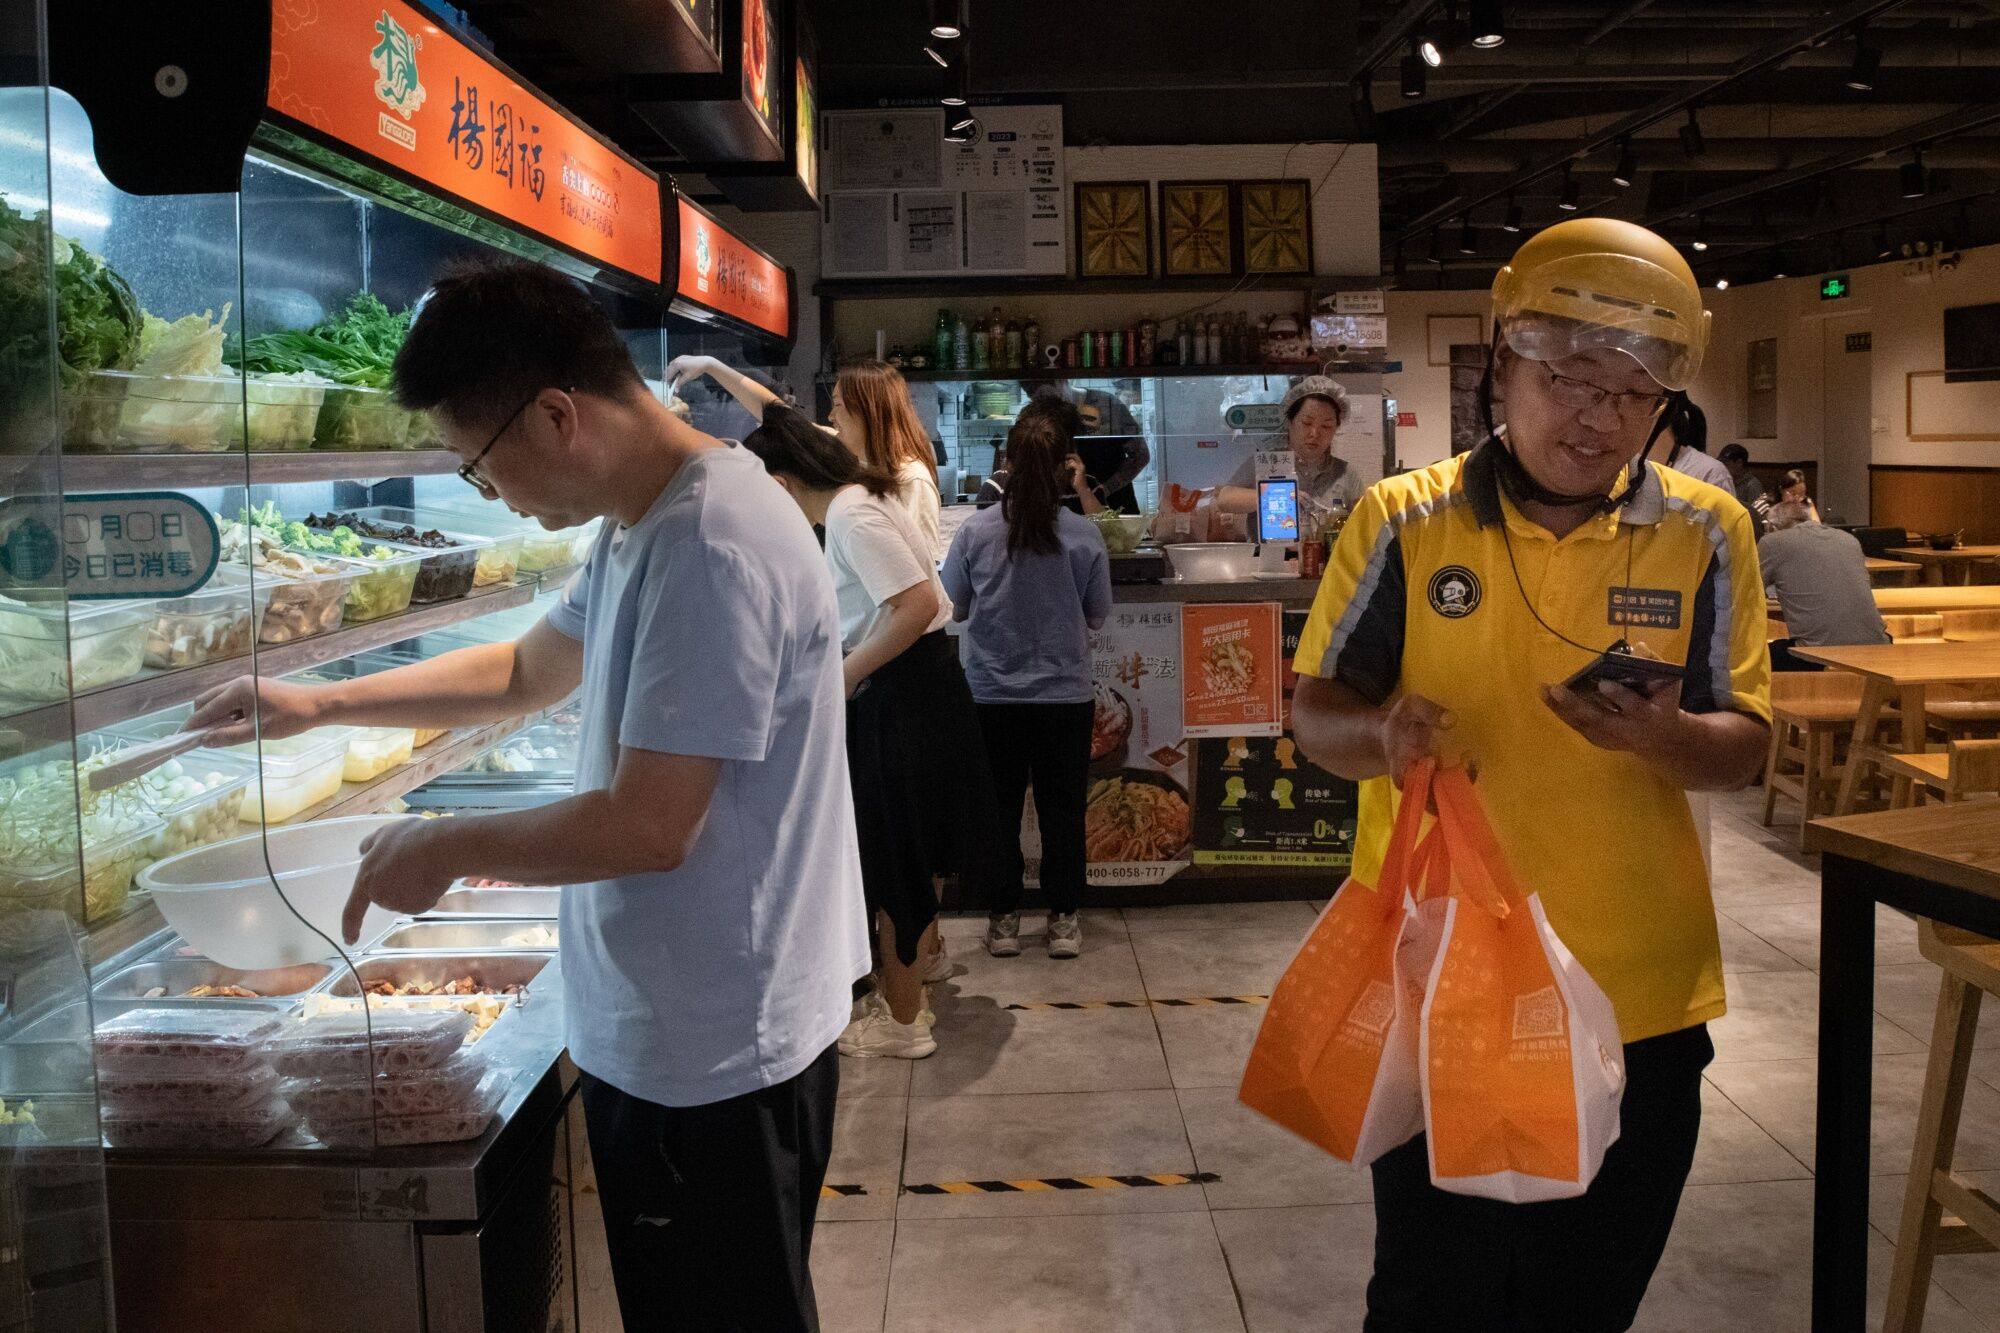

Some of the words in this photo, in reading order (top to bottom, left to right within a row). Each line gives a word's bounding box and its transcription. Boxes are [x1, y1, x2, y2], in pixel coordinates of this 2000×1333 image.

[100, 514, 122, 540] 月
[161, 513, 182, 538] 日
[65, 550, 193, 579] 今日已消毒
[1087, 867, 1165, 878] 400-6058-777
